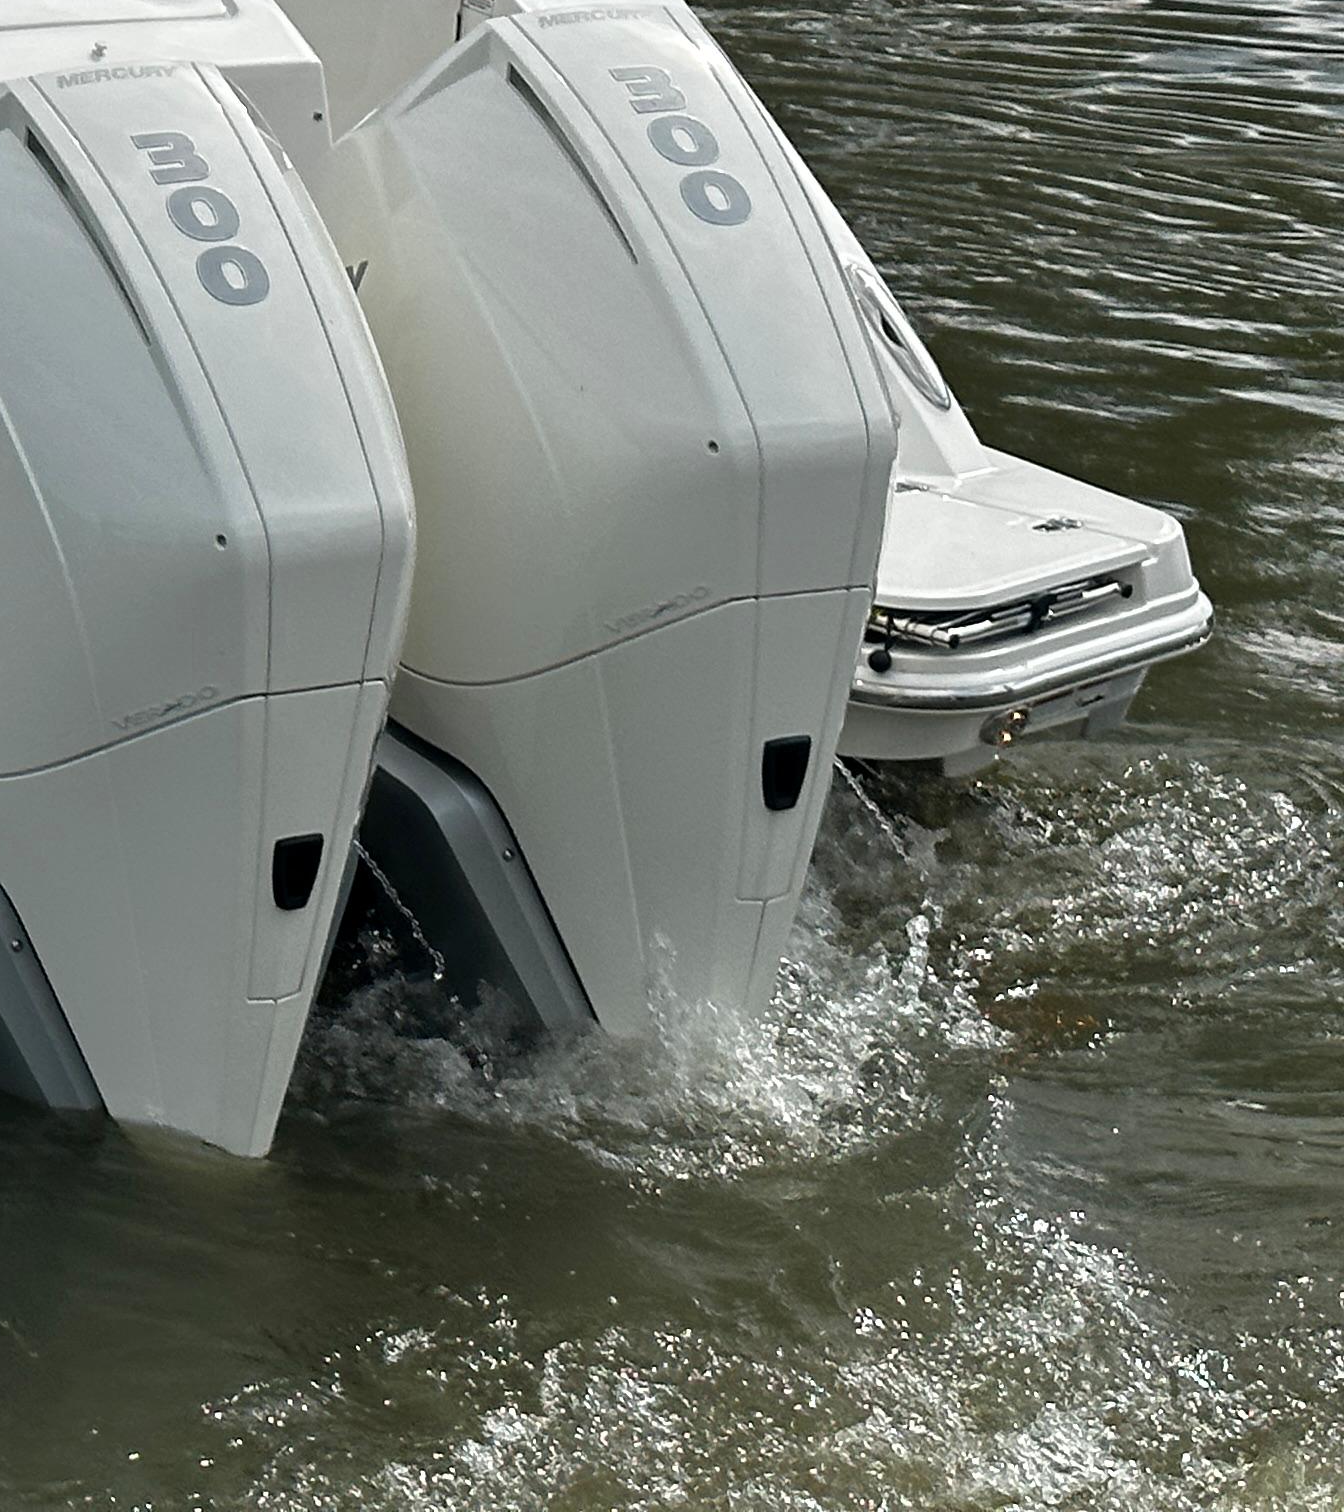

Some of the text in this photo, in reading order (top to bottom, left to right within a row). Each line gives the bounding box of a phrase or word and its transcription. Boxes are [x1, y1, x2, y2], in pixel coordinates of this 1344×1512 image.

[56, 64, 178, 90] MERCURY
[608, 64, 752, 226] 300
[129, 131, 270, 307] 300
